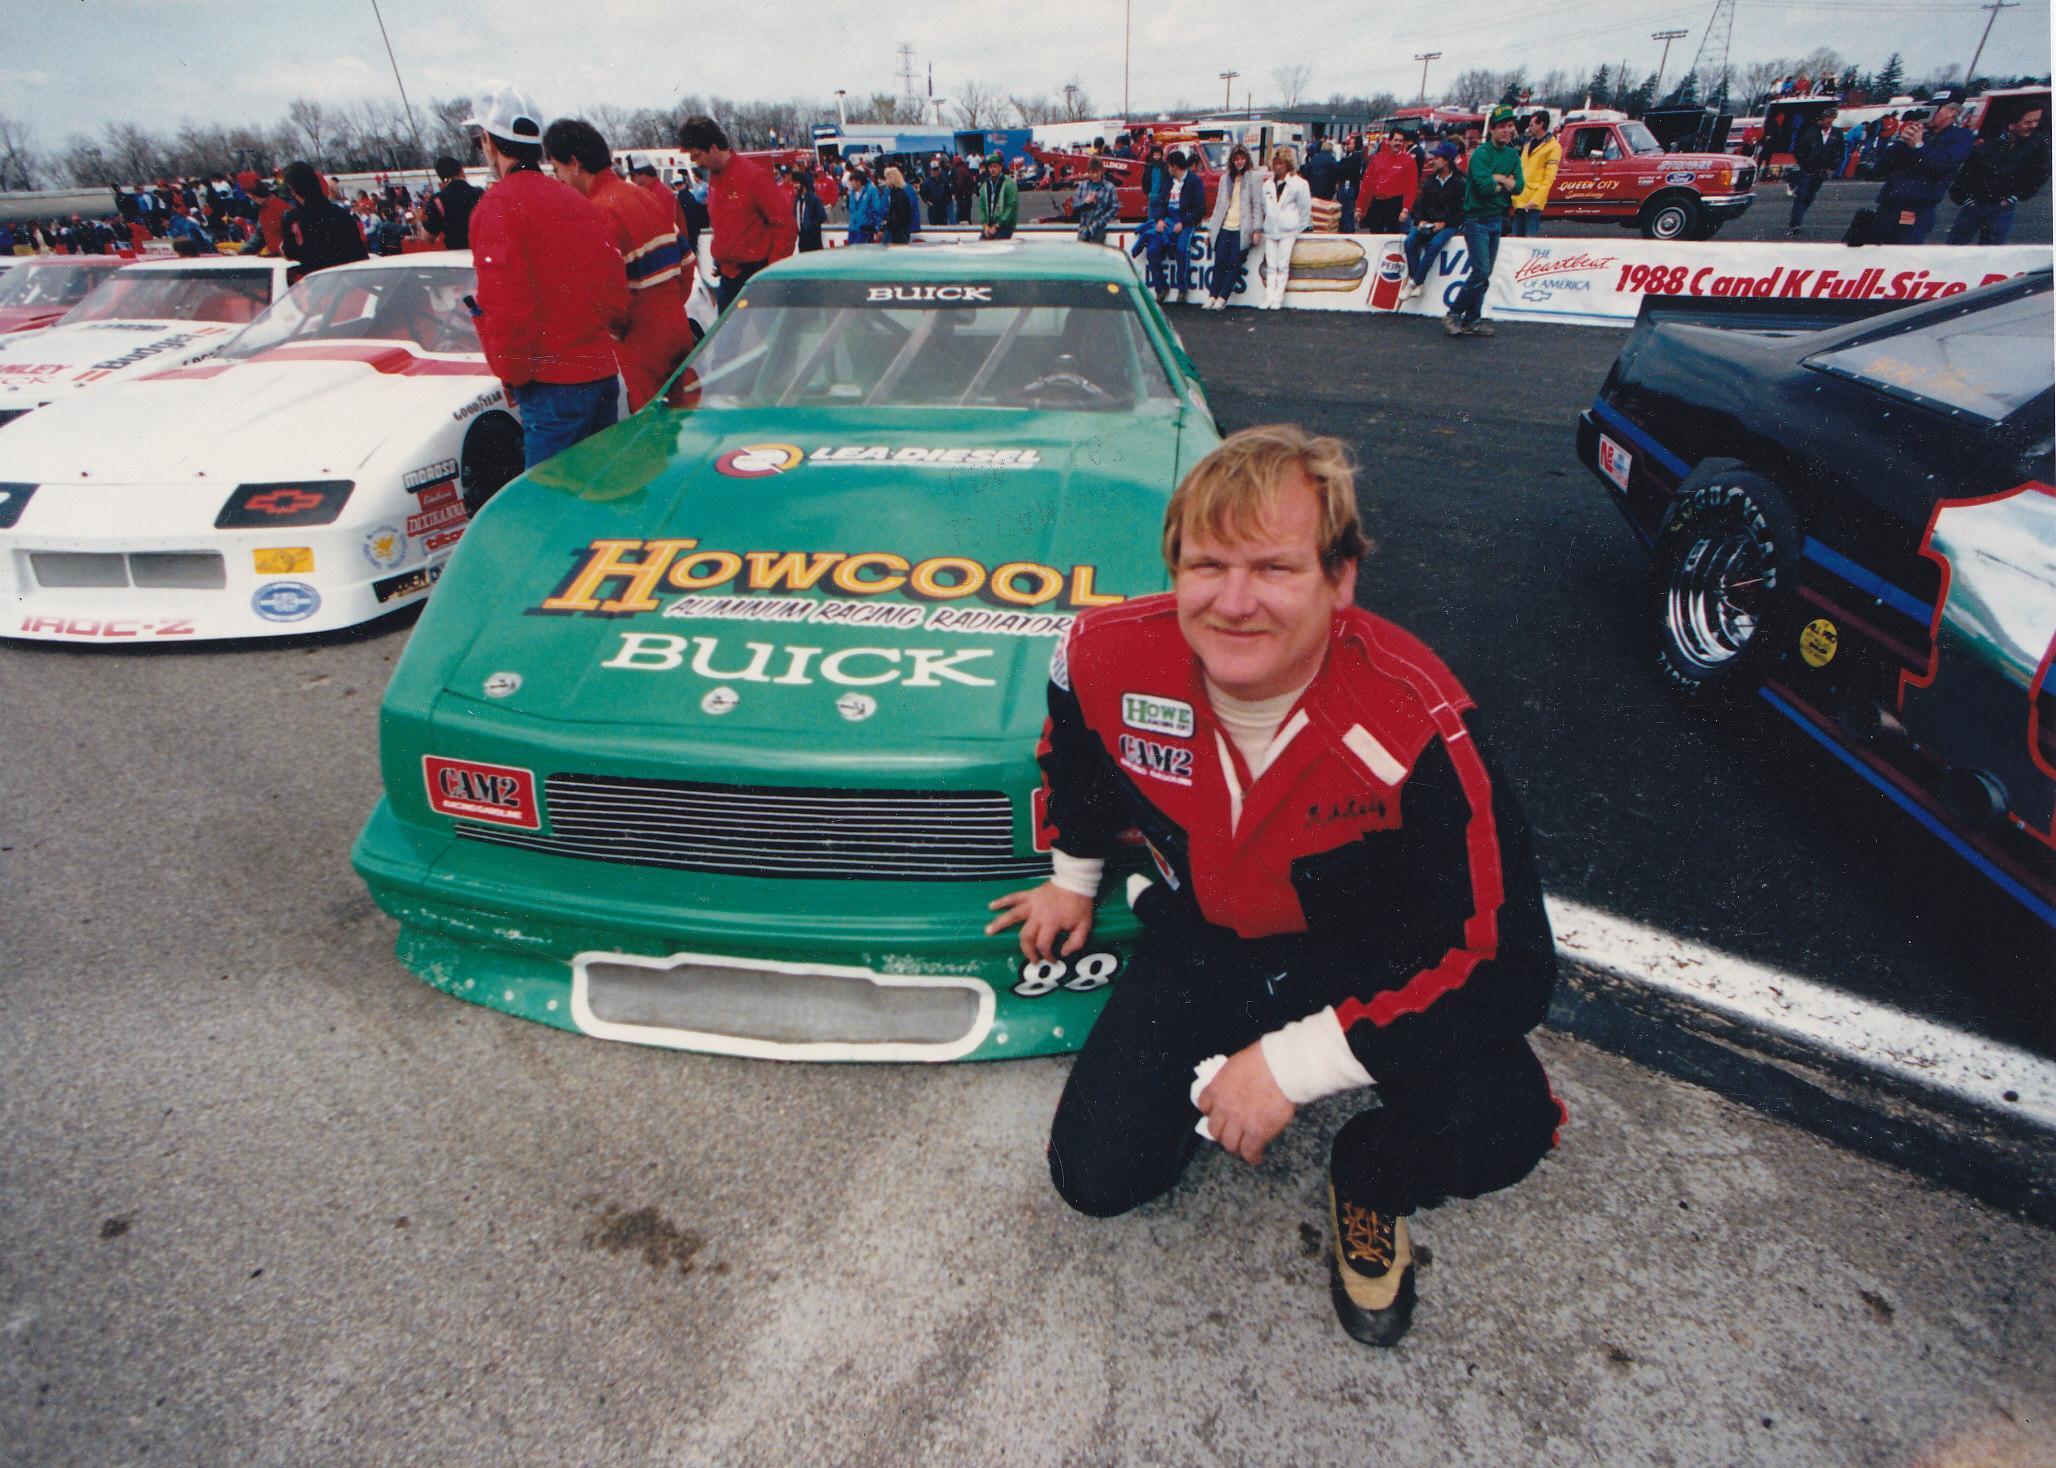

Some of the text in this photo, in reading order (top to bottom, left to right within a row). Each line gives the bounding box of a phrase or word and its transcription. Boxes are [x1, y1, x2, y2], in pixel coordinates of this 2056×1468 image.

[1557, 180, 1620, 192] QUEEN CITY
[1514, 253, 1619, 281] Heartbeat
[1531, 248, 1551, 258] THE
[866, 286, 993, 301] BUICK
[1523, 279, 1590, 291] OF AMERICA
[1616, 264, 1689, 296] 1988
[1689, 267, 1714, 296] C
[1711, 267, 1784, 297] and
[1779, 270, 1815, 297] K
[1809, 268, 1967, 300] Full-Size
[453, 391, 503, 421] GOODYEAR
[809, 446, 1041, 463] LEA DIESEL
[669, 598, 812, 619] ALUMINUM
[815, 602, 924, 627] RACING
[602, 632, 996, 687] BUICK
[1119, 733, 1193, 776] CAM2
[440, 767, 519, 807] CAM2
